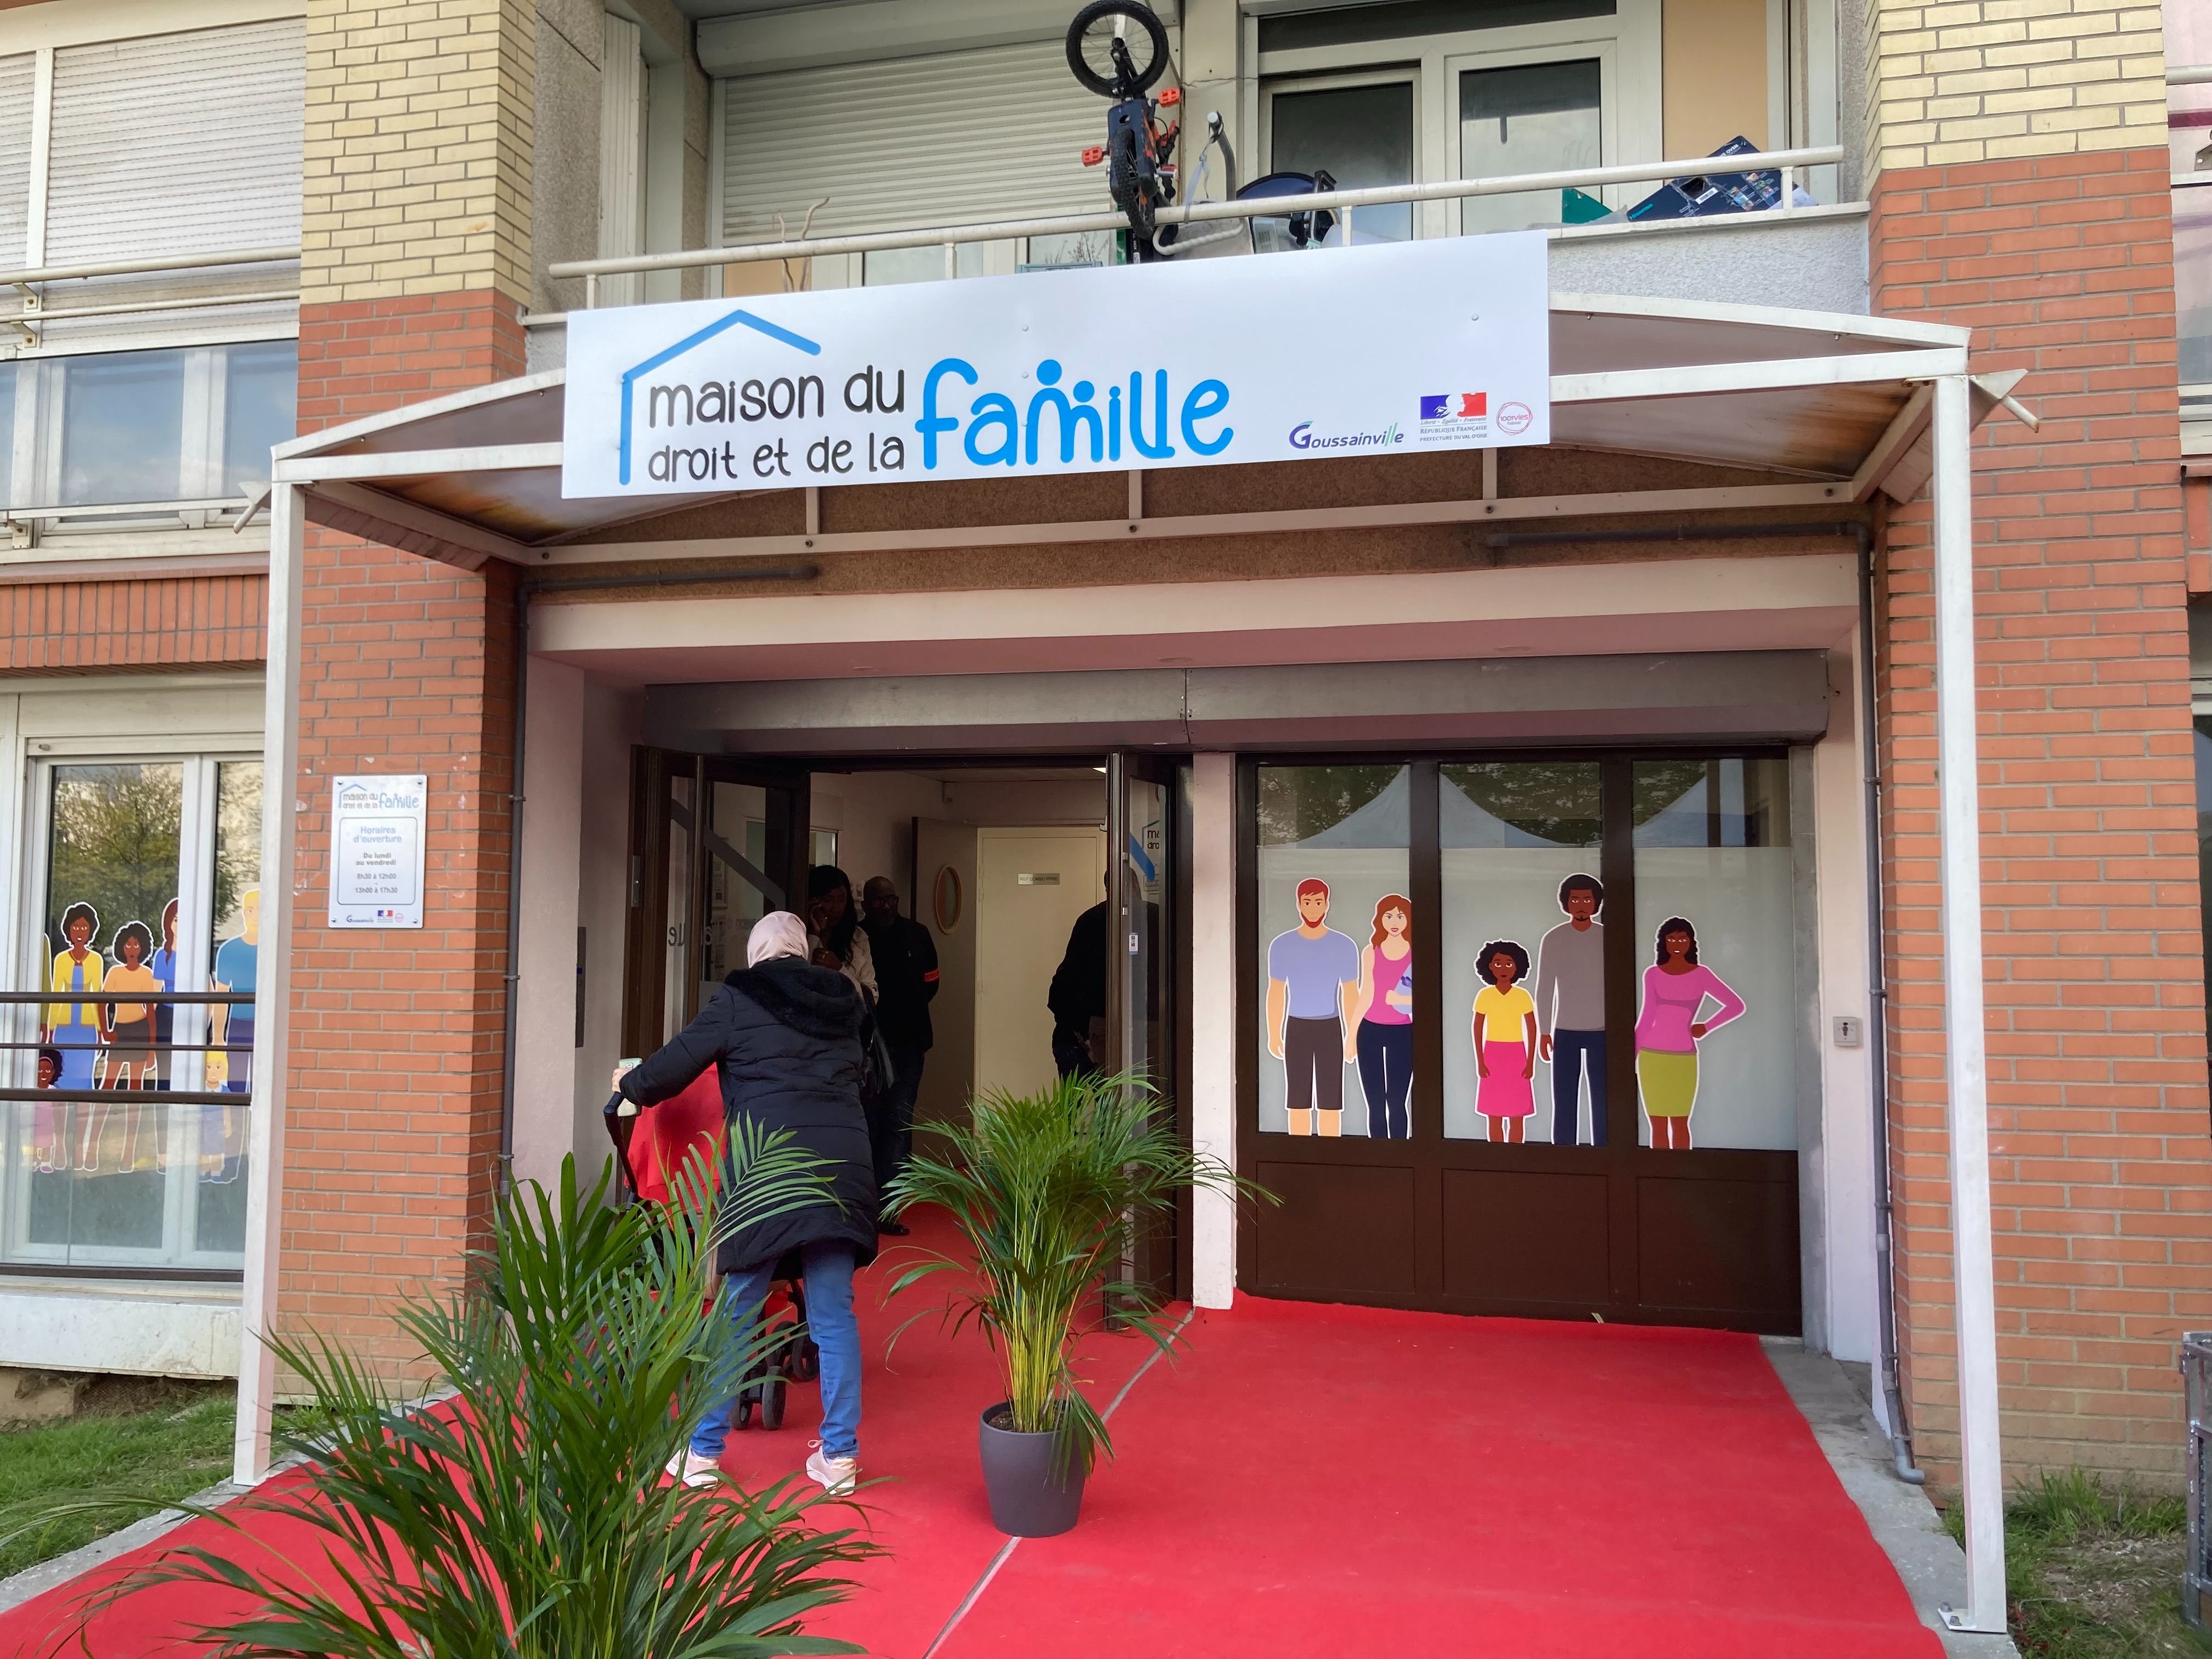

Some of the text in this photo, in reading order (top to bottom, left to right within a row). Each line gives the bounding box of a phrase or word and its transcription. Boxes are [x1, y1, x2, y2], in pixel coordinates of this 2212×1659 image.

[649, 365, 905, 427] maison du
[913, 358, 1234, 471] famille
[648, 432, 905, 482] droit et de la
[1289, 421, 1404, 449] Goussainville
